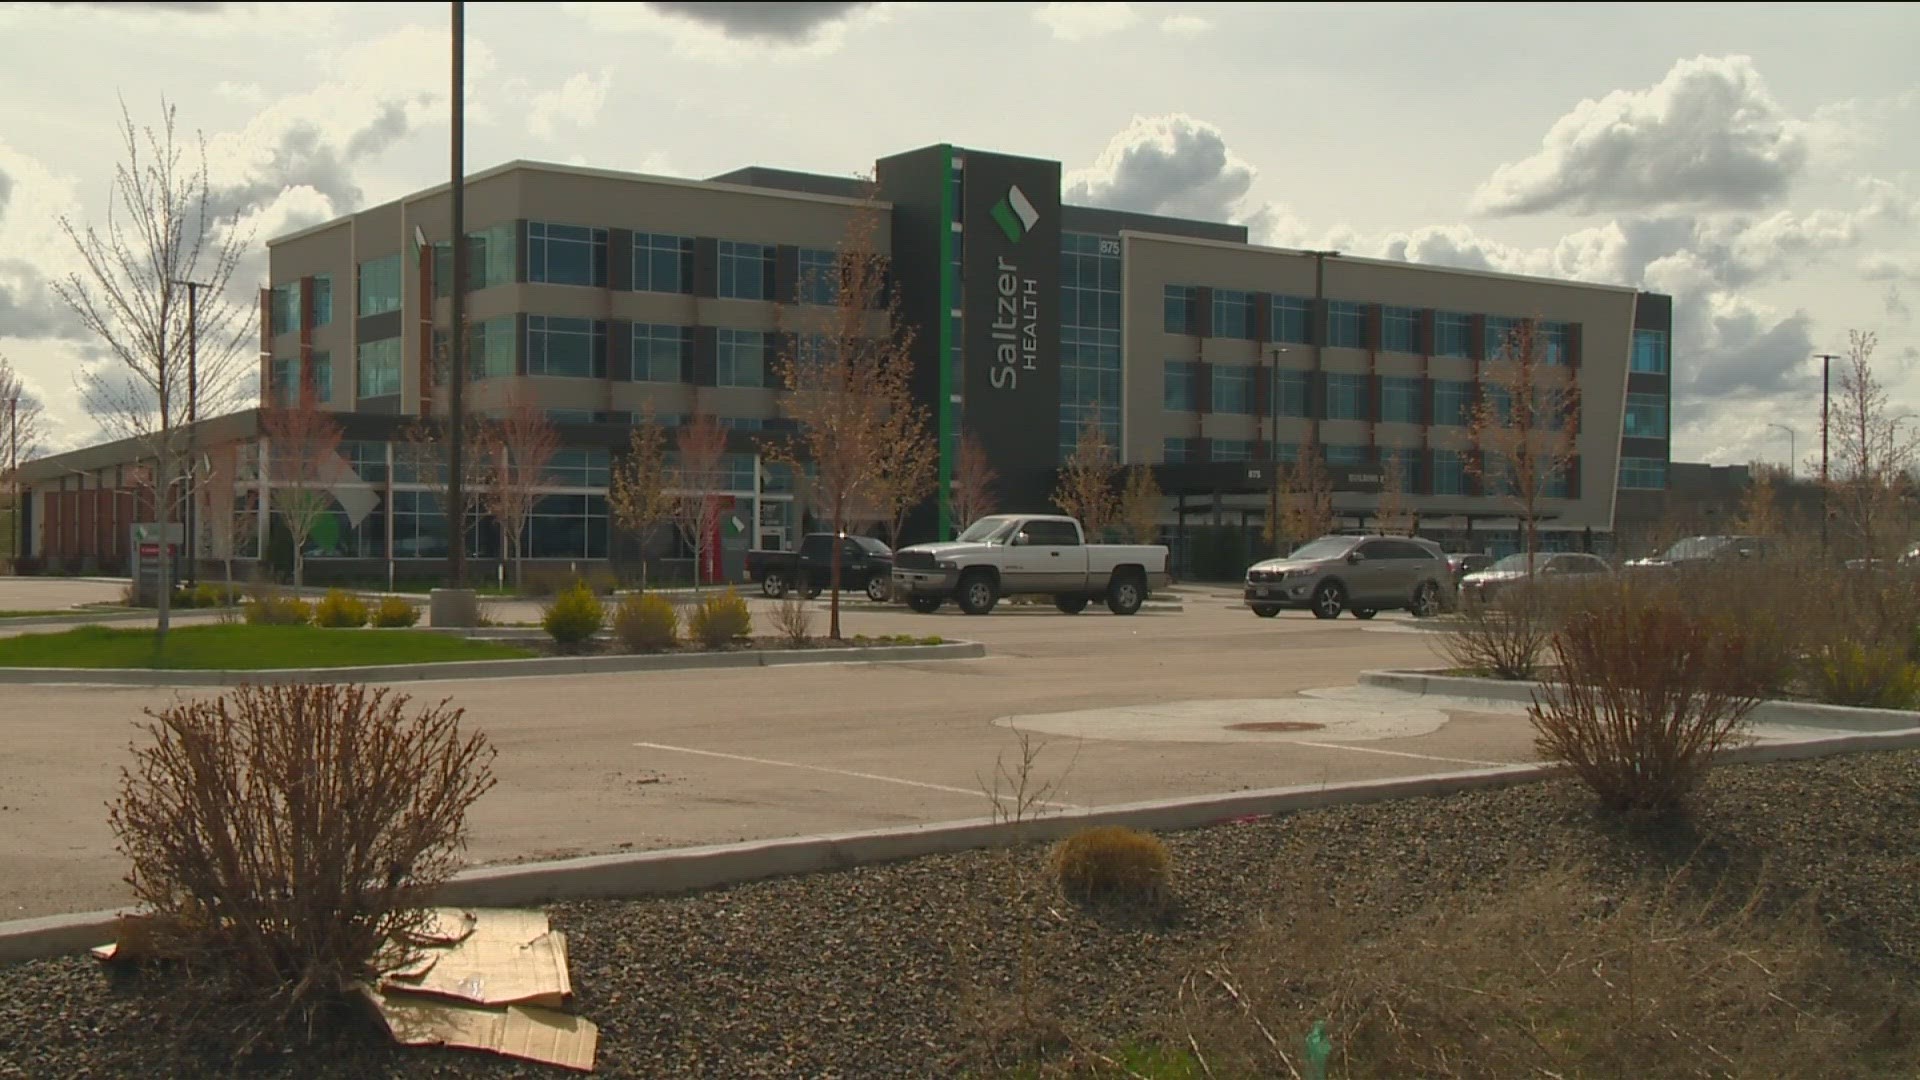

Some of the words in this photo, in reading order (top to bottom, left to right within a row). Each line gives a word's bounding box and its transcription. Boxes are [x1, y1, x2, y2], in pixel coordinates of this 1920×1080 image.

[1100, 240, 1120, 255] 875
[990, 256, 1017, 389] Saltzer
[1023, 279, 1037, 370] HEALTH
